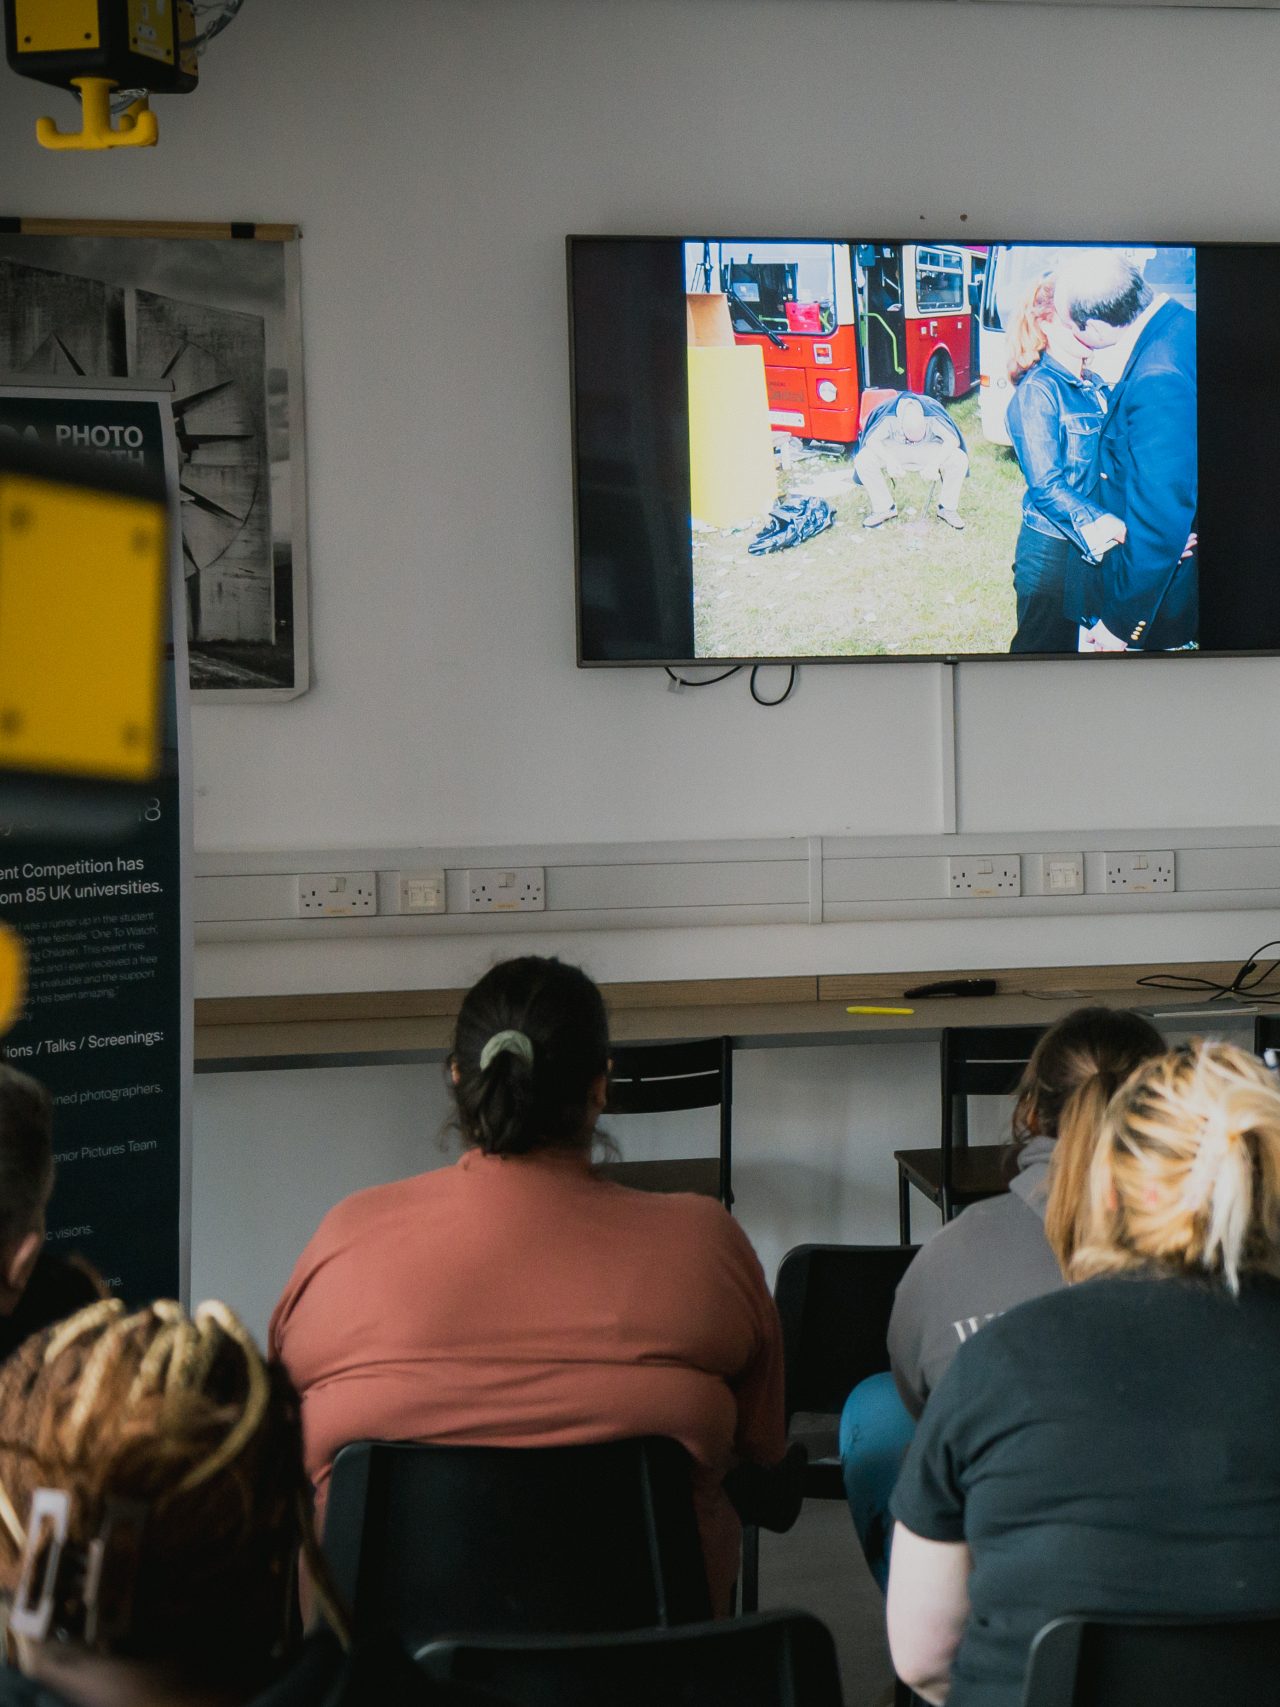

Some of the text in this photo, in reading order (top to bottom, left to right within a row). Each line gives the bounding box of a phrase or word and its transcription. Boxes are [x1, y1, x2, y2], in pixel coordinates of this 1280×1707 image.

[55, 424, 144, 448] PHOTO
[22, 859, 114, 880] Competition
[117, 856, 144, 871] has
[26, 887, 46, 902] 85
[49, 884, 72, 900] UK
[75, 879, 163, 898] universities.
[44, 1038, 76, 1054] Talks
[88, 1031, 164, 1048] Screenings:
[53, 1083, 163, 1105] ned photographers.
[52, 1140, 157, 1164] enior Pictures Team
